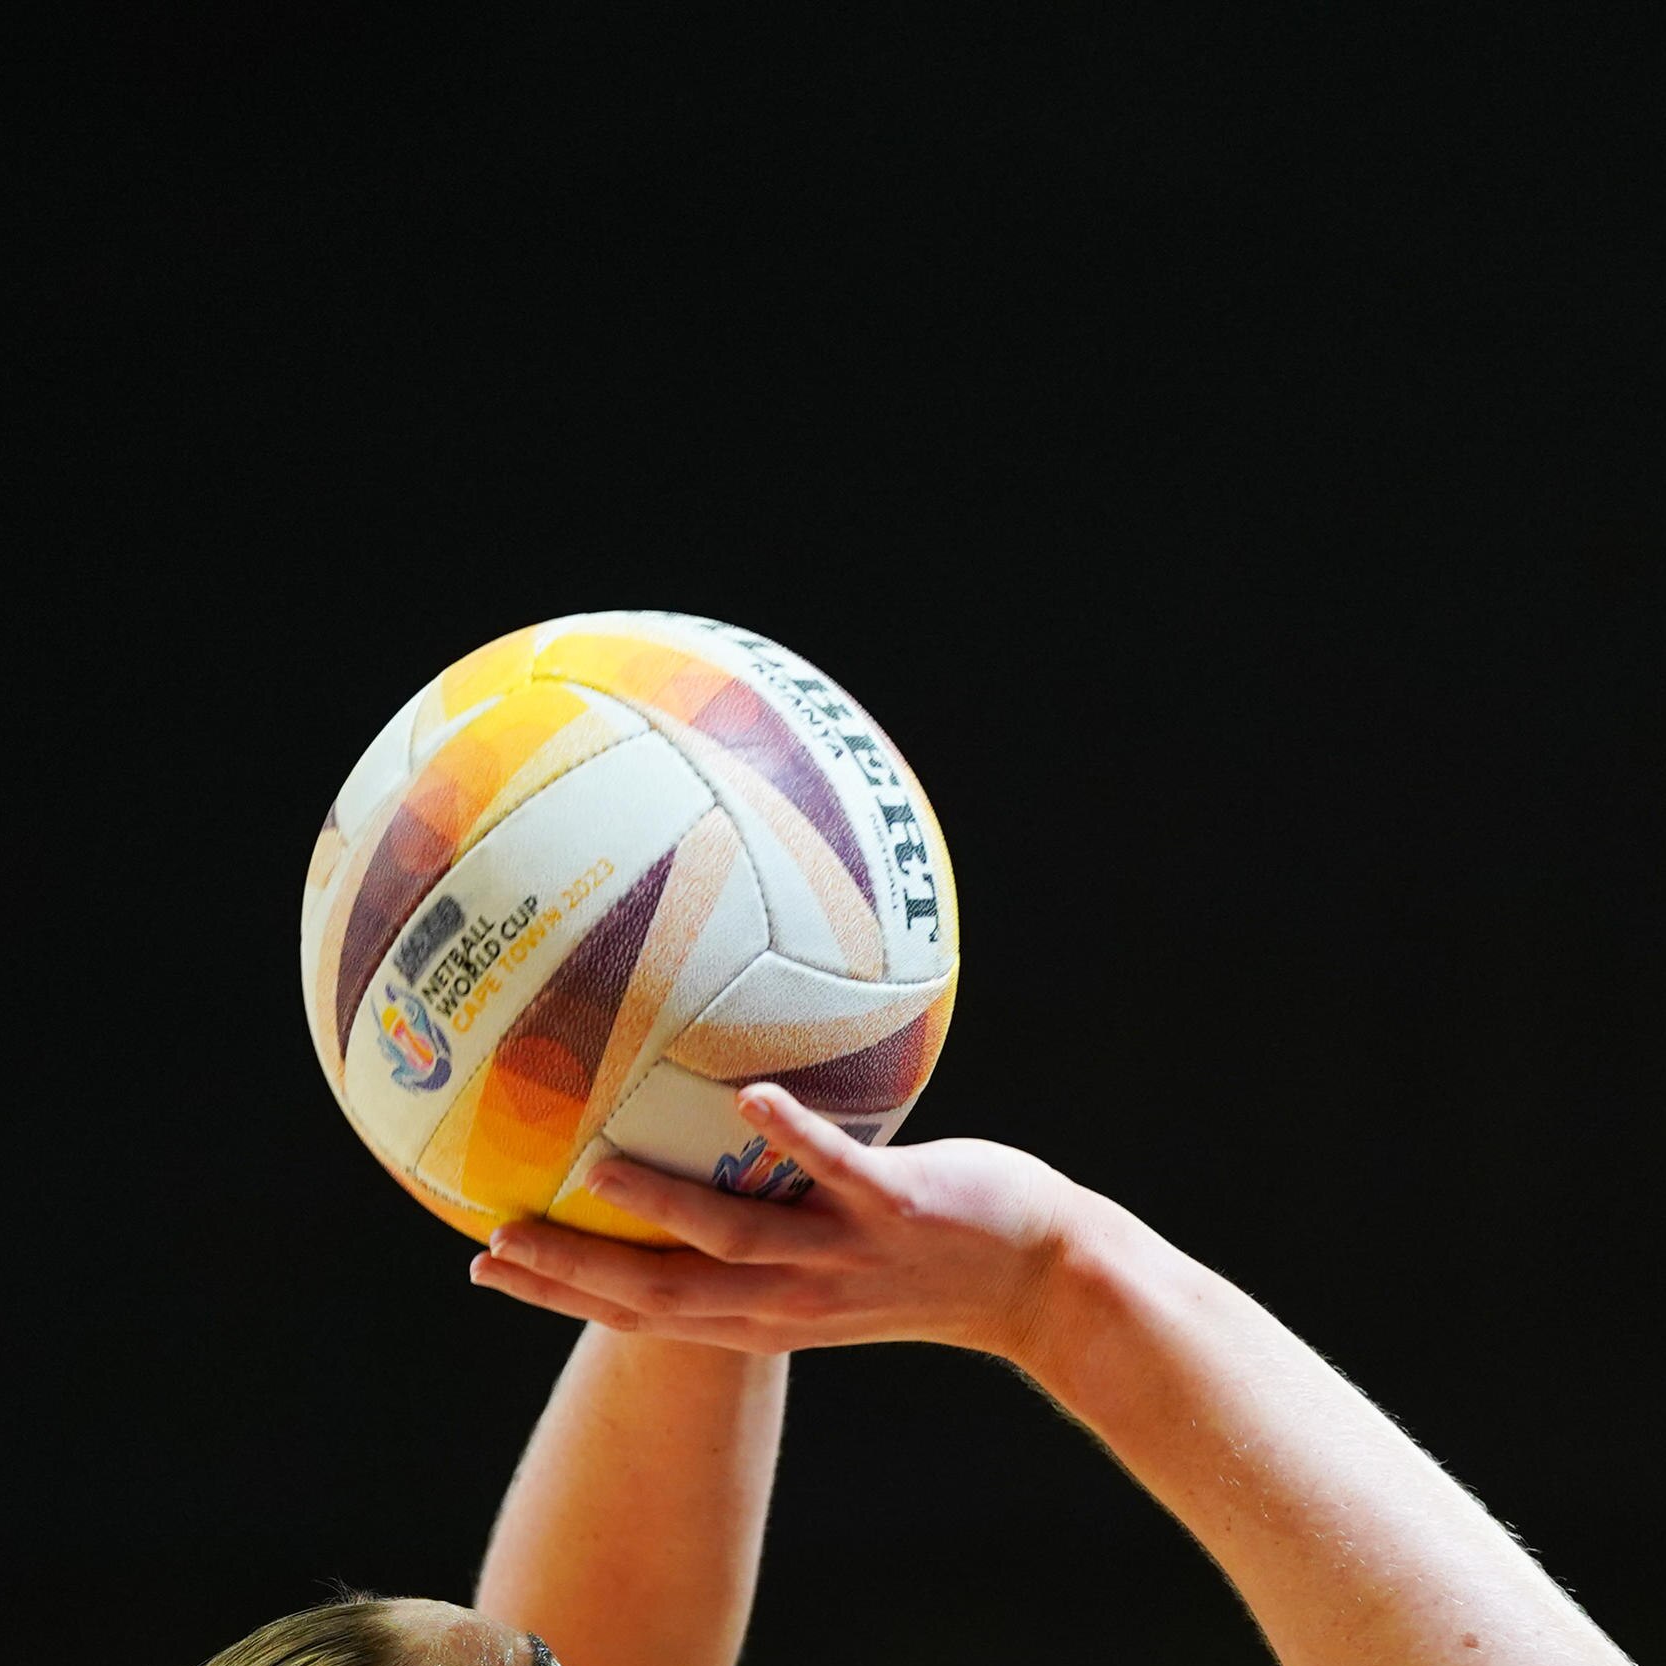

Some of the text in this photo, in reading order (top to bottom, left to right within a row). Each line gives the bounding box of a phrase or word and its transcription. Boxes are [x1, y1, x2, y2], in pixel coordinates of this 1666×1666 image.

[663, 611, 940, 942] LBERT
[422, 915, 497, 1004] NETBALL
[435, 894, 539, 1018] WORLD CUP
[452, 857, 616, 1034] CAPE TOWN 2023
